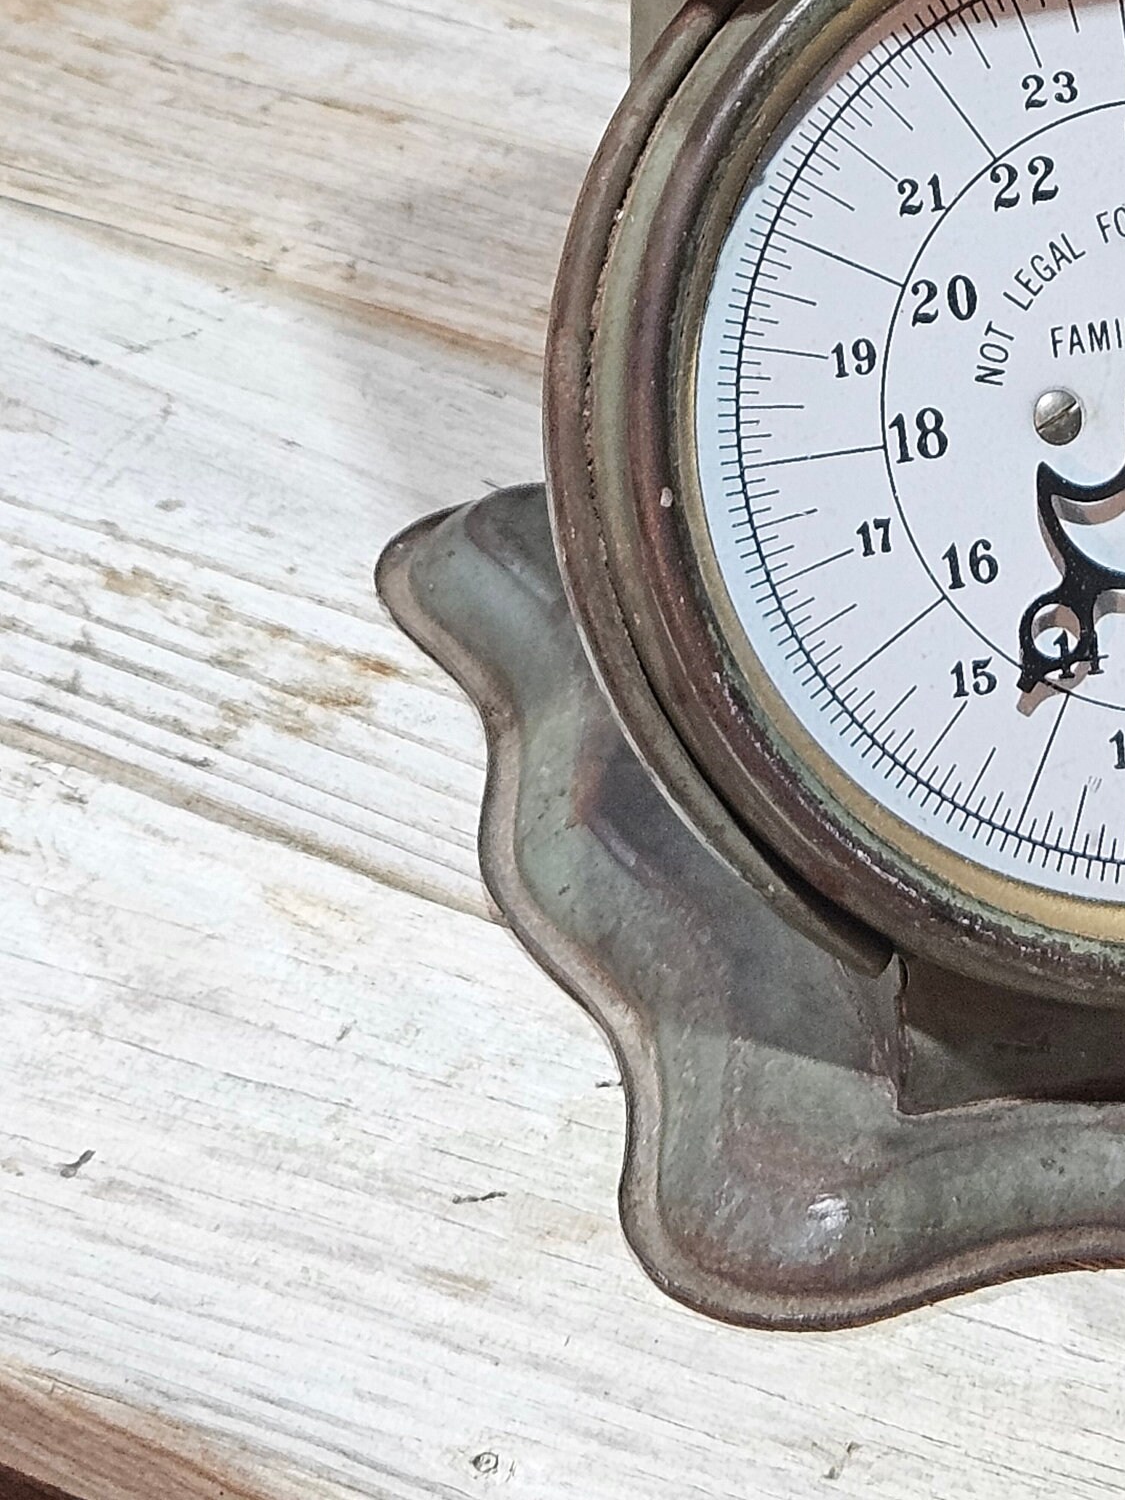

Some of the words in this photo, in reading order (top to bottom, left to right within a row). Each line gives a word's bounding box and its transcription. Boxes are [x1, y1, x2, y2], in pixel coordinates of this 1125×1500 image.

[1022, 71, 1078, 111] 23
[897, 174, 945, 217] 21
[989, 155, 1059, 212] 22
[911, 274, 978, 328] 20
[974, 320, 1014, 386] NOT
[1003, 233, 1086, 311] LEGAL
[831, 338, 877, 379] 19
[888, 407, 948, 464] 18
[856, 517, 892, 558] 17
[941, 538, 999, 590] 16
[950, 656, 998, 699] 15
